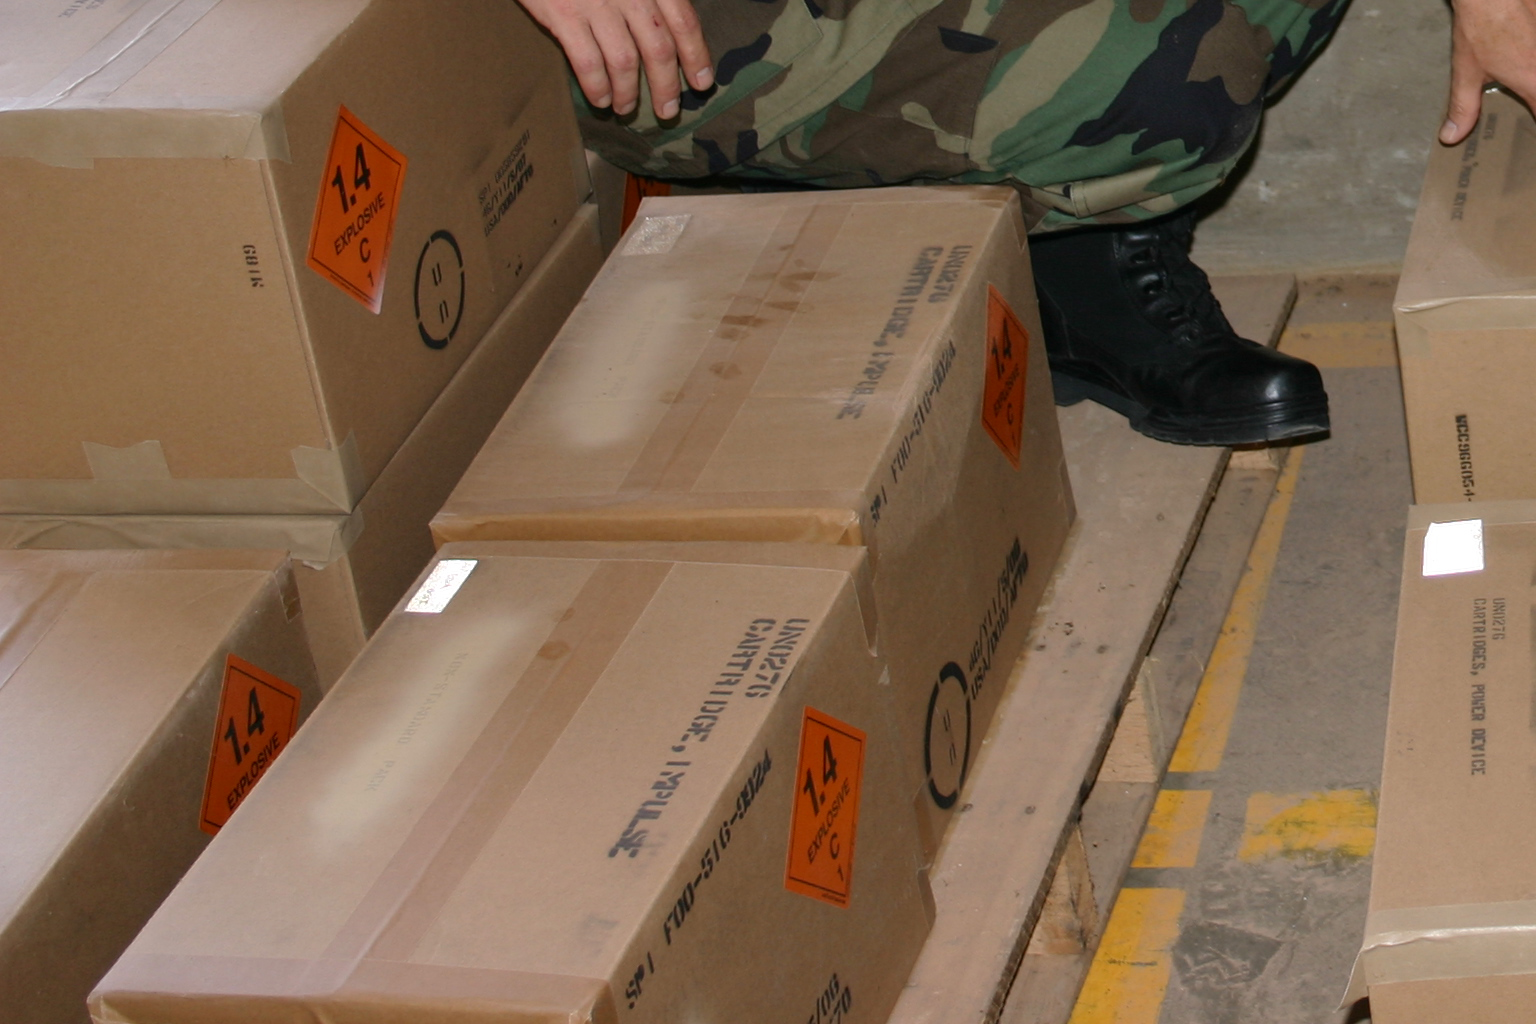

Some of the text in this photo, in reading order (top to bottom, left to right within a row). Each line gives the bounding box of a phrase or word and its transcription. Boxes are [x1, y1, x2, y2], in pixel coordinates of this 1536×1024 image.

[331, 142, 372, 215] 1.4
[333, 191, 386, 256] EXPLOSIVE
[359, 237, 372, 264] C
[366, 269, 375, 288] 1
[991, 316, 1012, 381] 1.4
[1492, 597, 1506, 641] UN0276
[670, 617, 777, 754] CARTRIDGE,
[744, 617, 811, 699] UN0276
[1470, 598, 1487, 776] CARTRIDGES, POWER DEVICE
[224, 685, 265, 767] 1.4
[227, 731, 282, 812] EXPLOSIVE
[364, 760, 396, 792] PACK
[803, 733, 838, 818] 1.4
[807, 777, 851, 865] EXPLOSIVE
[829, 831, 841, 861] C
[836, 866, 844, 883] 1
